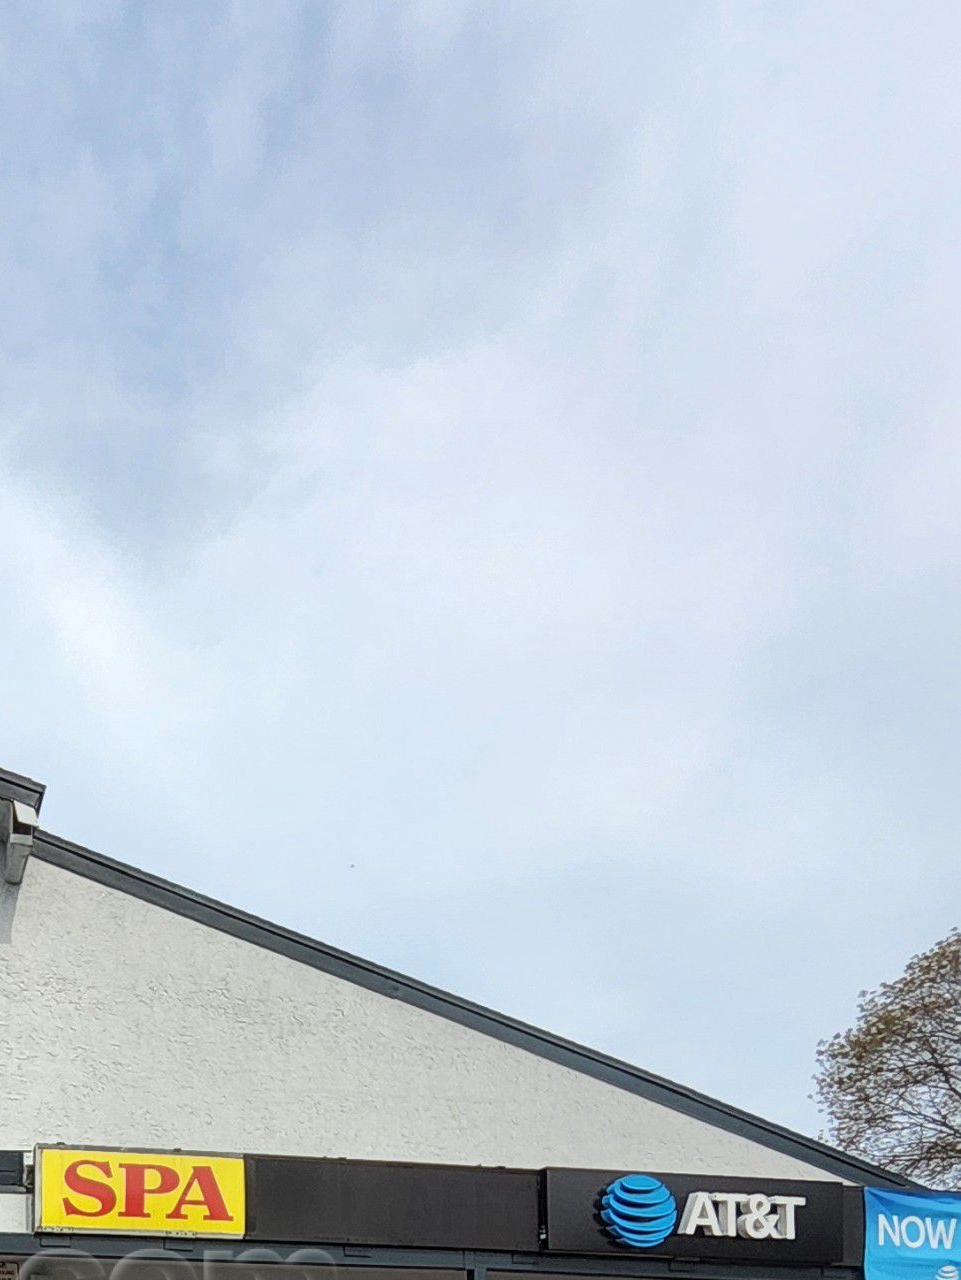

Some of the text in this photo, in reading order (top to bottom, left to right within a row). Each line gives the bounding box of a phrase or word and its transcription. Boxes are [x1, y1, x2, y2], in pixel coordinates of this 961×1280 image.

[62, 1159, 234, 1222] SPA
[677, 1191, 806, 1240] AT&T
[877, 1214, 957, 1250] NOW
